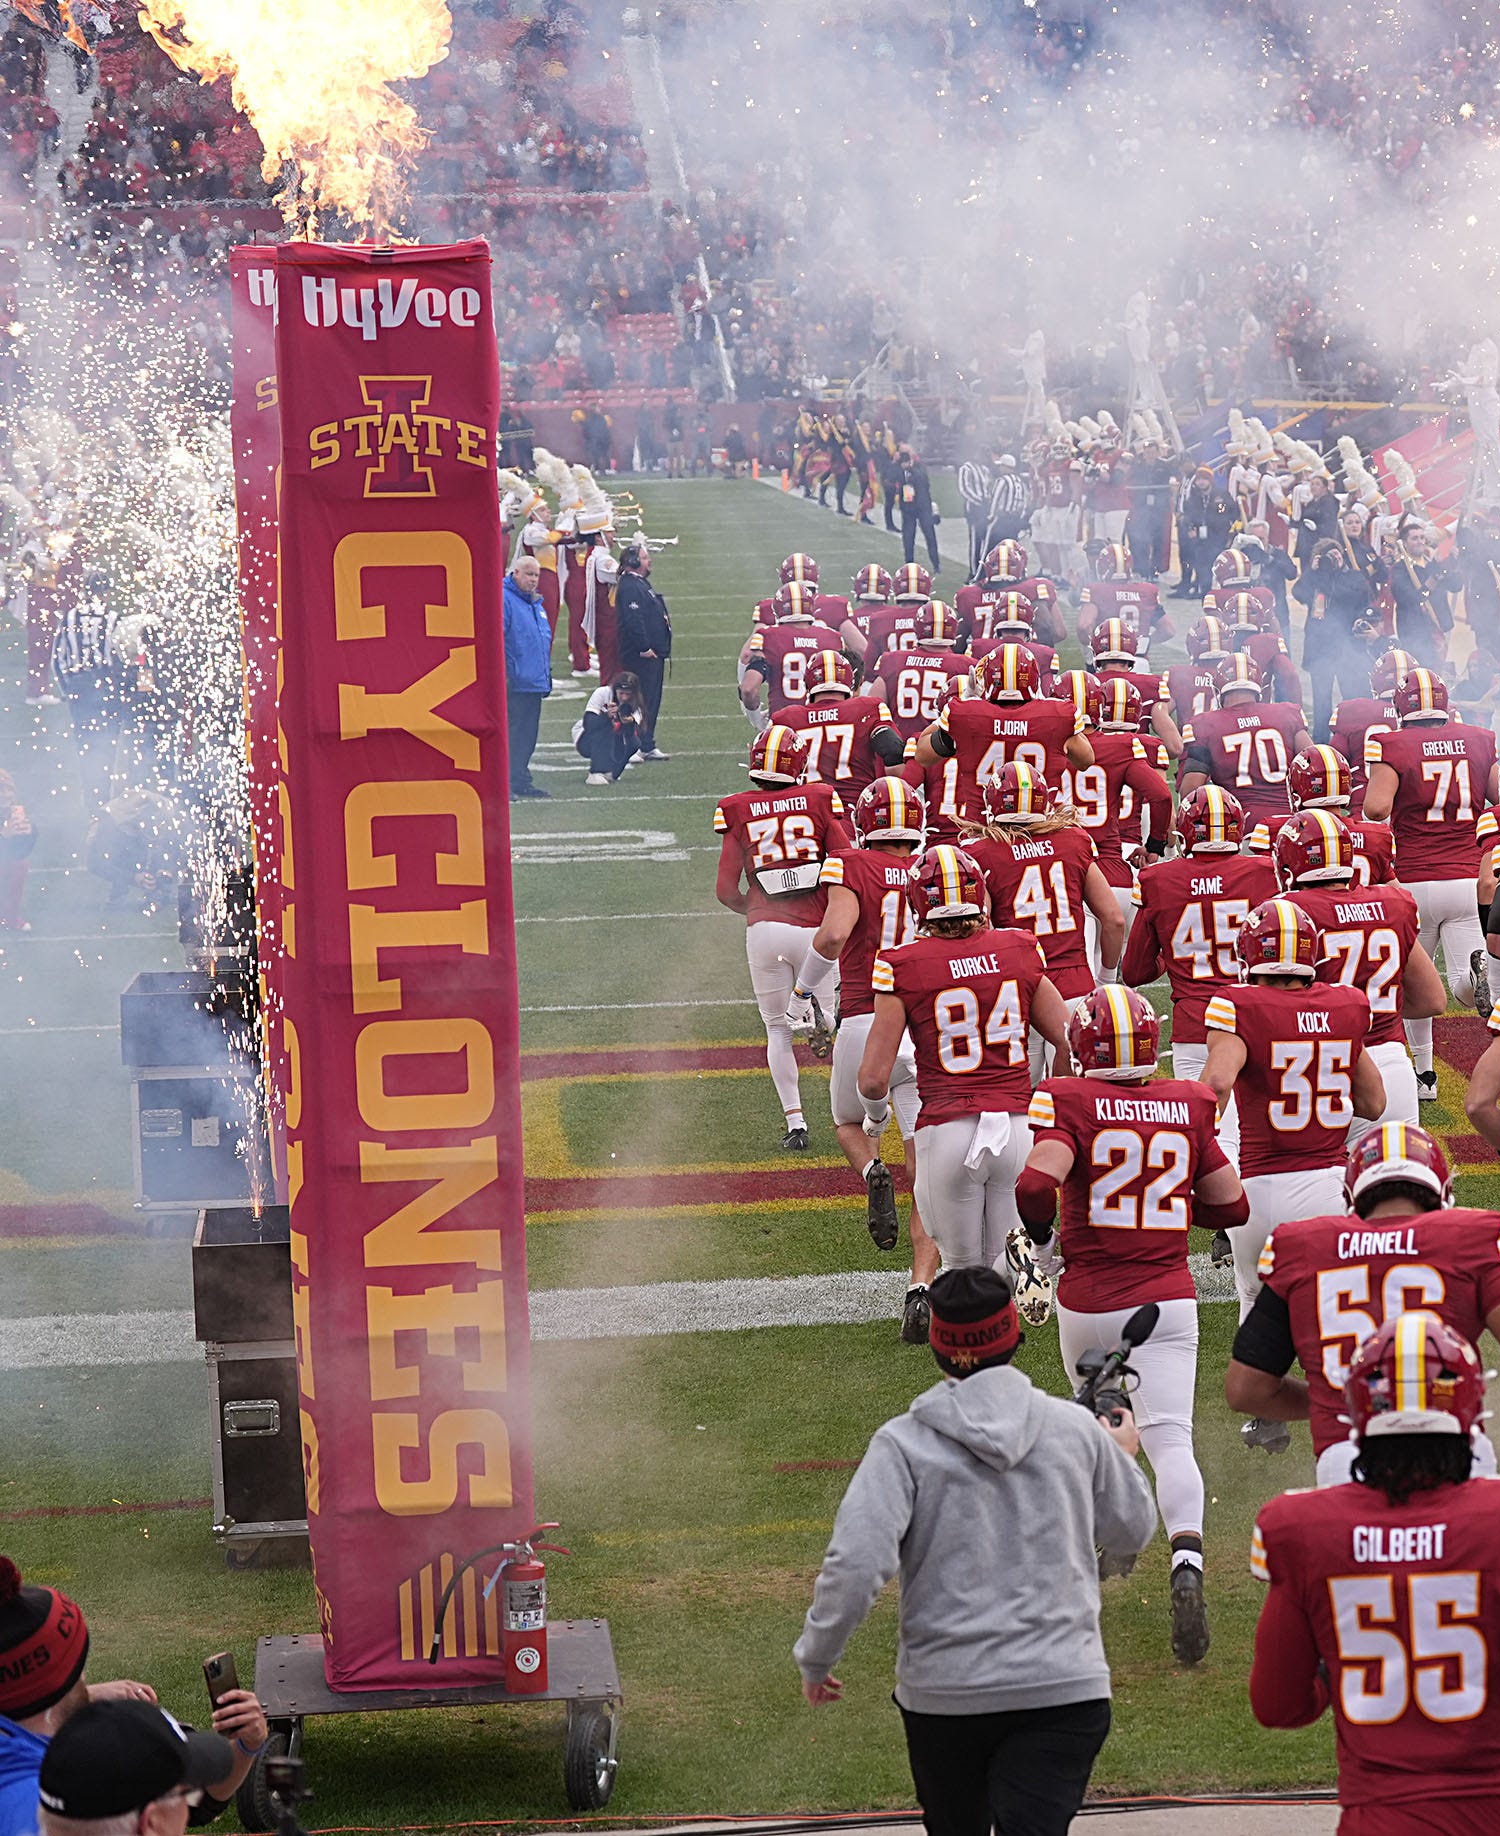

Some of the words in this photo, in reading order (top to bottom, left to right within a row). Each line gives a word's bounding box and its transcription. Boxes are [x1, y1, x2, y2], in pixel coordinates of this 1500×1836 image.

[301, 275, 481, 341] HyVee
[309, 413, 488, 470] STATE
[974, 604, 995, 640] 7
[793, 637, 818, 649] MOORE
[906, 656, 943, 668] RUTLEDGE
[897, 669, 948, 719] 65
[808, 708, 839, 723] ELEDGE
[993, 719, 1028, 737] BJORN
[1237, 715, 1261, 729] BUHR
[797, 724, 855, 783] 77
[1222, 728, 1289, 787] 70
[1422, 740, 1466, 757] GREENLEE
[750, 802, 770, 816] VAN
[773, 796, 807, 811] DINTER
[1421, 759, 1474, 822] 71
[746, 815, 819, 868] 36
[1011, 840, 1055, 861] BARNES
[884, 867, 908, 885] BRA
[1013, 860, 1077, 936] 41
[1334, 901, 1386, 924] BARRETT
[1171, 898, 1249, 980] 45
[949, 953, 1000, 979] BURKLE
[1322, 928, 1402, 1014] 72
[333, 530, 513, 1516] CYCLONES
[934, 979, 1026, 1074] 84
[1296, 1011, 1331, 1034] KOCK
[1268, 1039, 1353, 1131] 35
[1095, 1097, 1190, 1125] KLOSTERMAN
[1088, 1128, 1191, 1231] 22
[1338, 1228, 1419, 1260] CARNELL
[934, 1315, 1011, 1347] CLONES
[1352, 1523, 1447, 1563] GILBERT
[1326, 1570, 1489, 1725] 55
